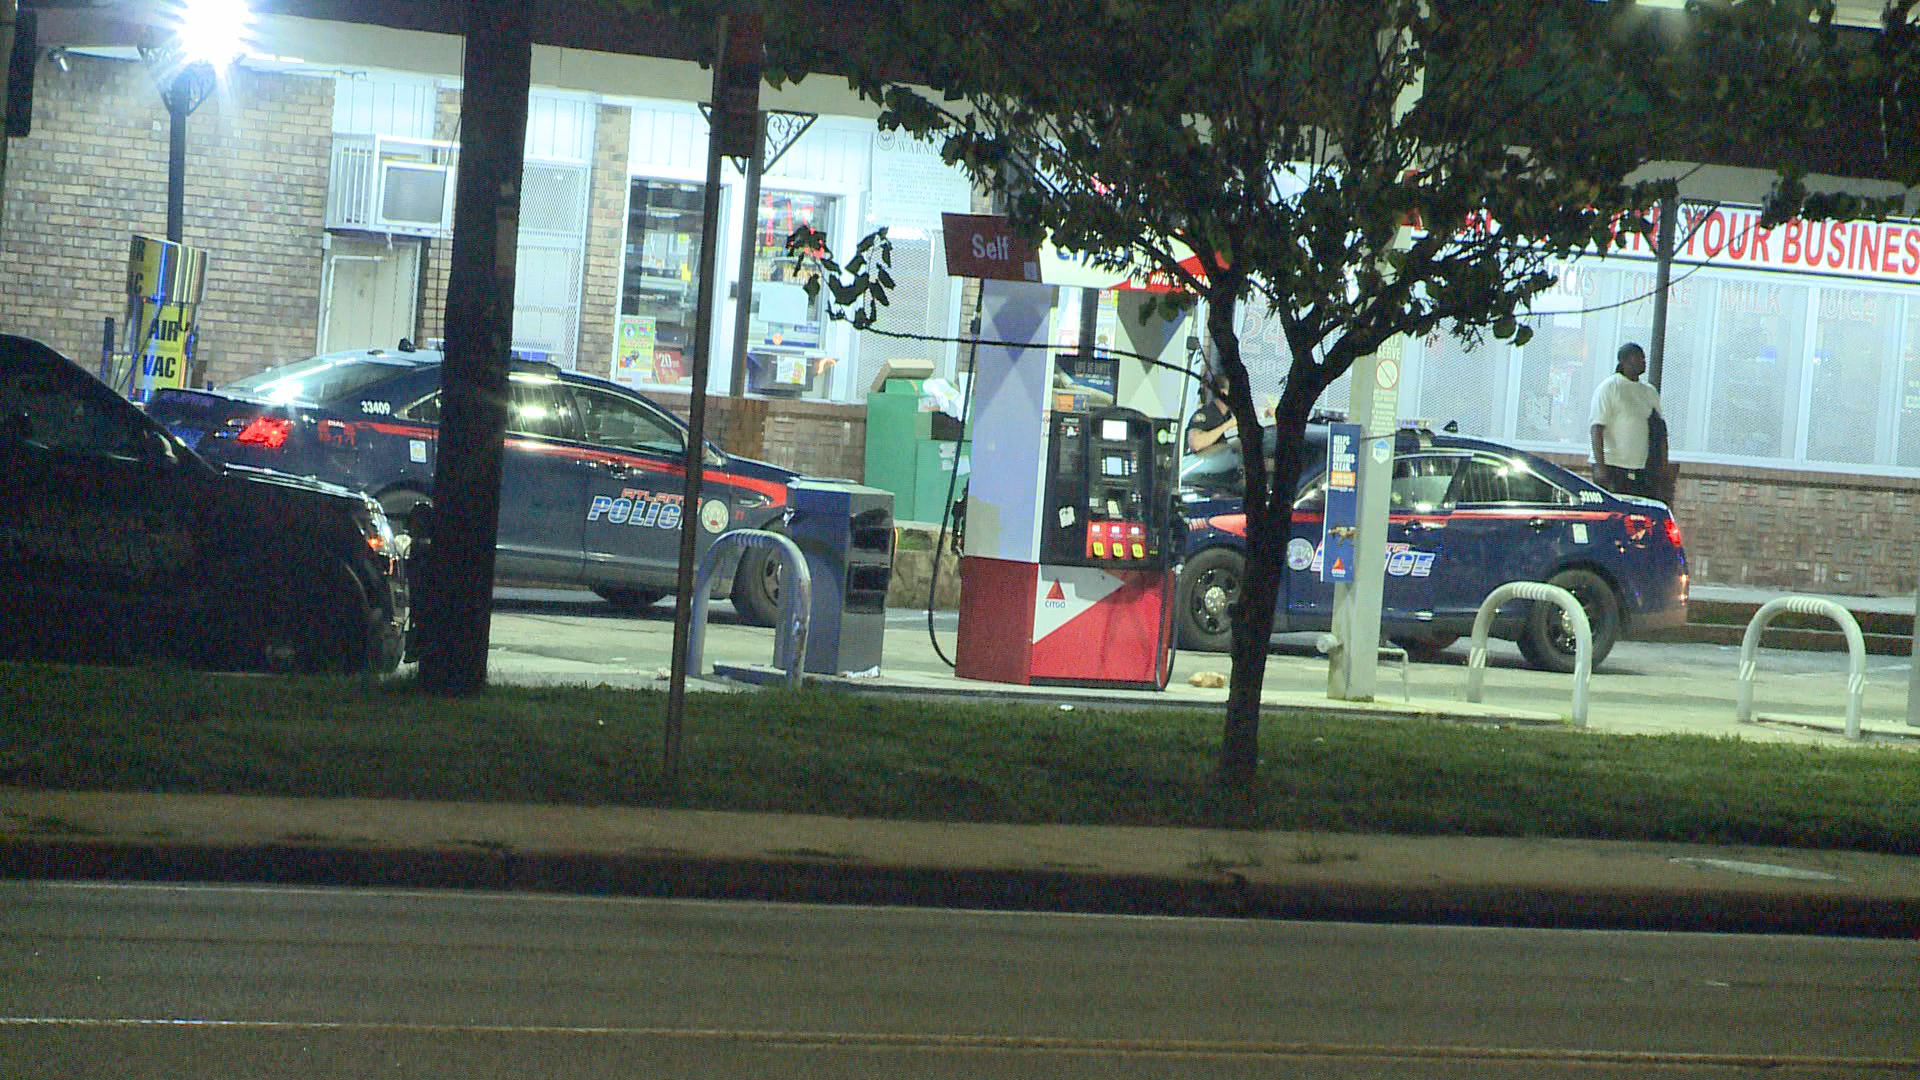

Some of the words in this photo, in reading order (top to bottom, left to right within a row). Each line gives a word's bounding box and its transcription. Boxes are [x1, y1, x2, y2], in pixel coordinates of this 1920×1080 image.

[897, 140, 943, 156] WARNIN
[1684, 205, 1770, 263] YOUR
[971, 233, 1009, 261] Self
[1720, 281, 1783, 315] MILK
[149, 317, 179, 342] AIR
[142, 354, 177, 379] VAC
[361, 400, 391, 416] 33409
[587, 495, 684, 531] POLIC
[1044, 600, 1066, 609] CITGO
